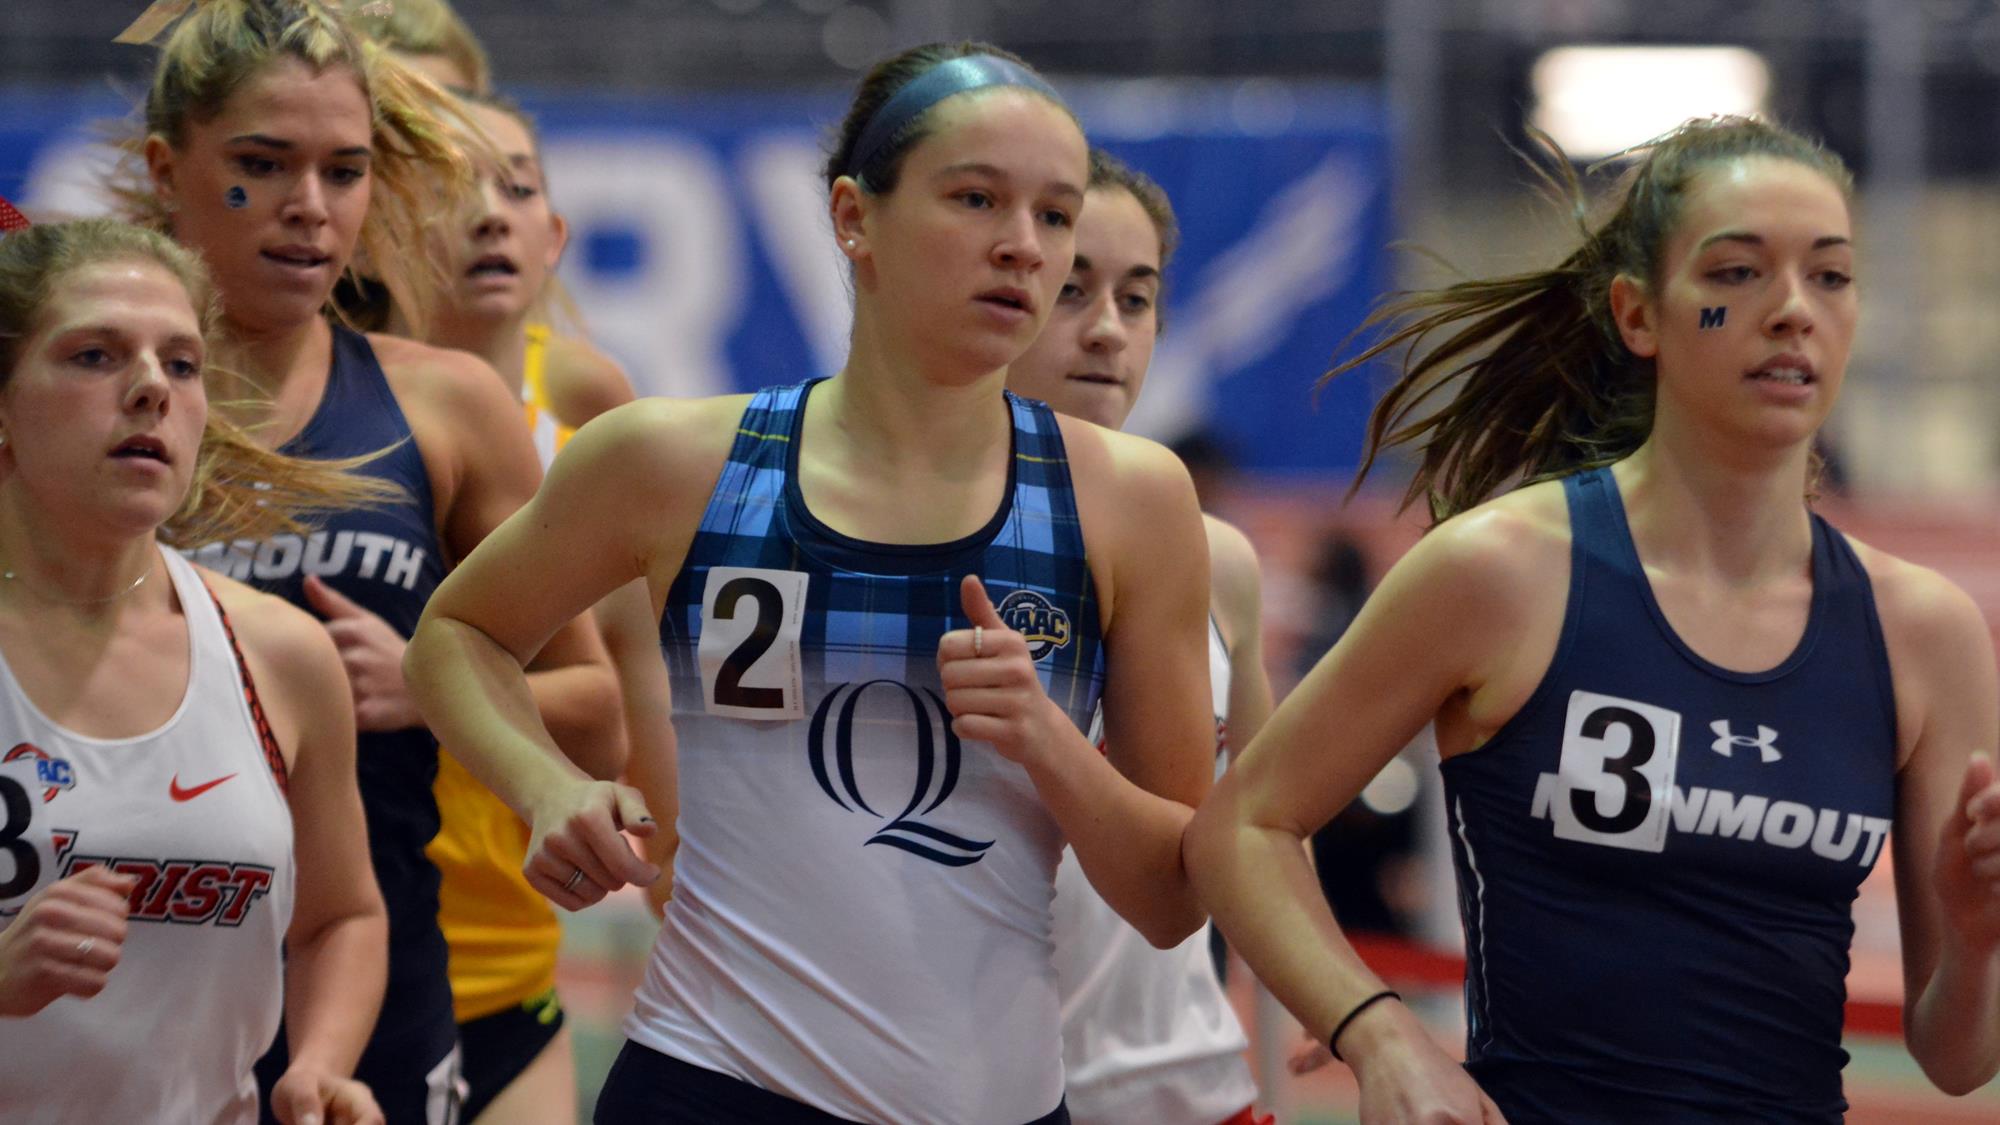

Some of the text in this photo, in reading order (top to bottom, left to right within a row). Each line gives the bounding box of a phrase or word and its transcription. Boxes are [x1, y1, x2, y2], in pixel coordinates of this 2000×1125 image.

[1699, 306, 1728, 330] M
[180, 530, 426, 592] MOUTH
[713, 577, 784, 709] 2
[1000, 607, 1069, 644] AAC
[37, 757, 71, 785] AC
[808, 679, 996, 867] Q
[1570, 706, 1656, 834] 3
[1530, 772, 1893, 867] NMOUT
[50, 828, 275, 927] RIST
